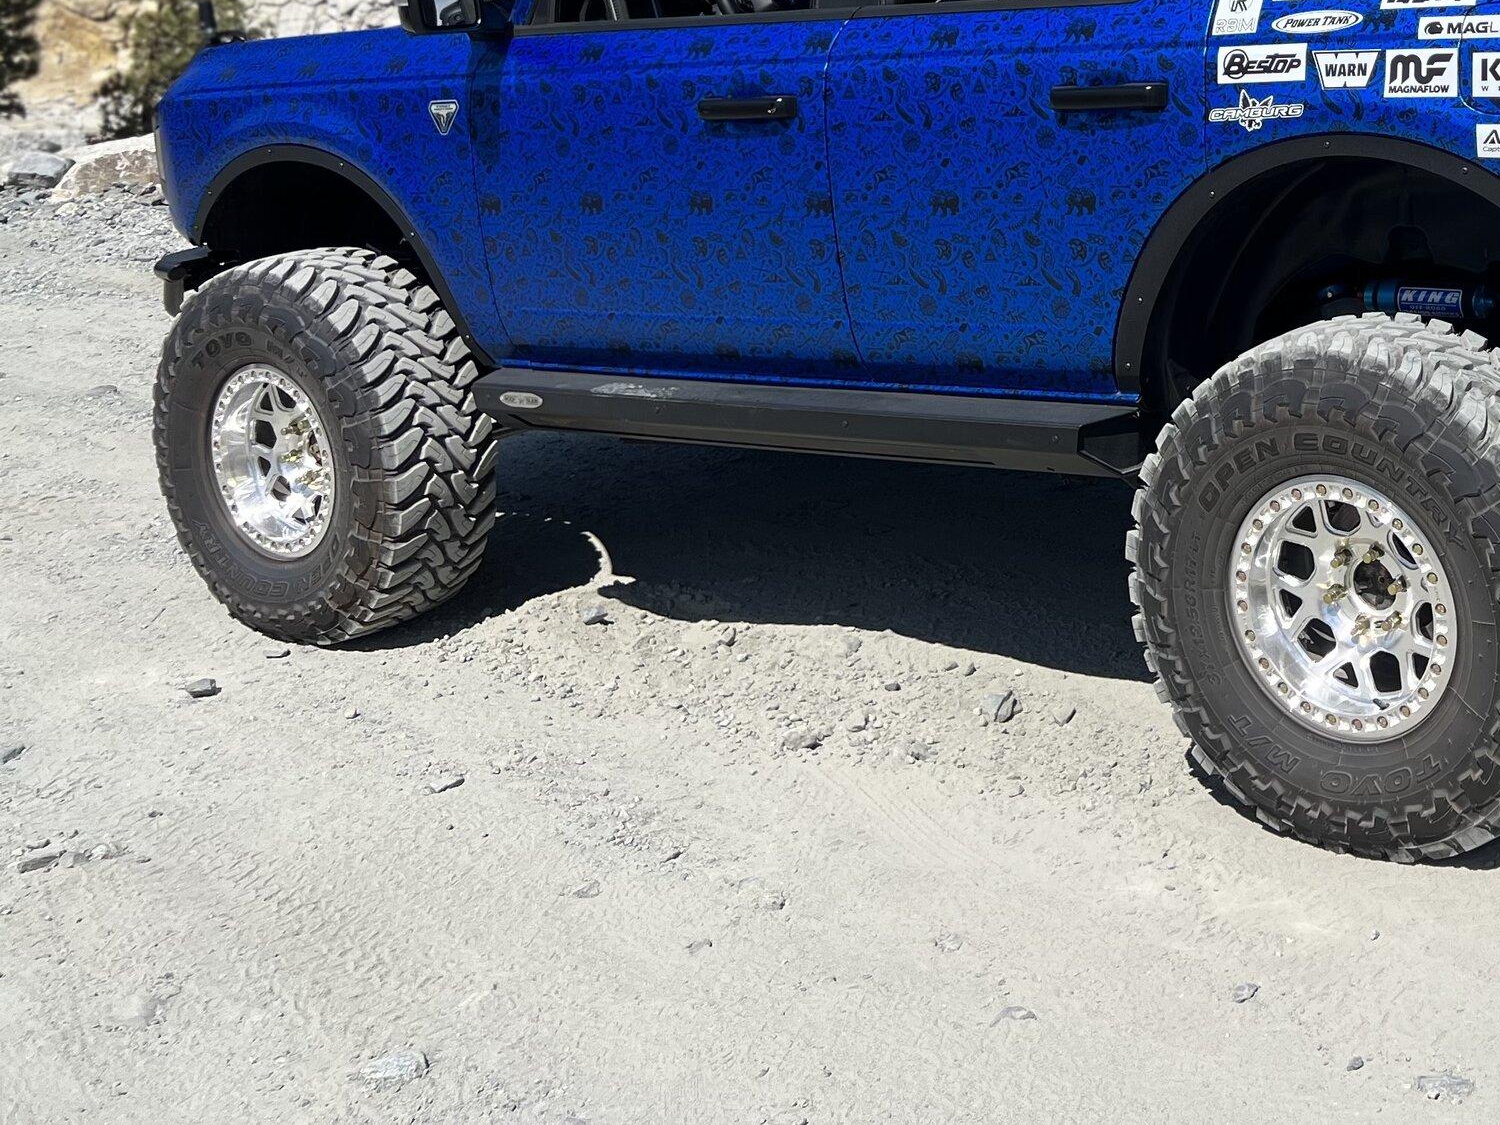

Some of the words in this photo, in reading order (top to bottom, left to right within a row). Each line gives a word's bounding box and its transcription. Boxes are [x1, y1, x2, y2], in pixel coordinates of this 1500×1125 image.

[1283, 17, 1320, 29] POWER
[1321, 14, 1353, 26] TANK
[1325, 63, 1368, 77] WARN
[1388, 84, 1450, 94] MAGNAFLOW
[1210, 104, 1303, 120] CAMBURG
[1400, 289, 1460, 304] KING
[1198, 436, 1281, 513] OPEN
[1293, 432, 1465, 549] COUNTRY
